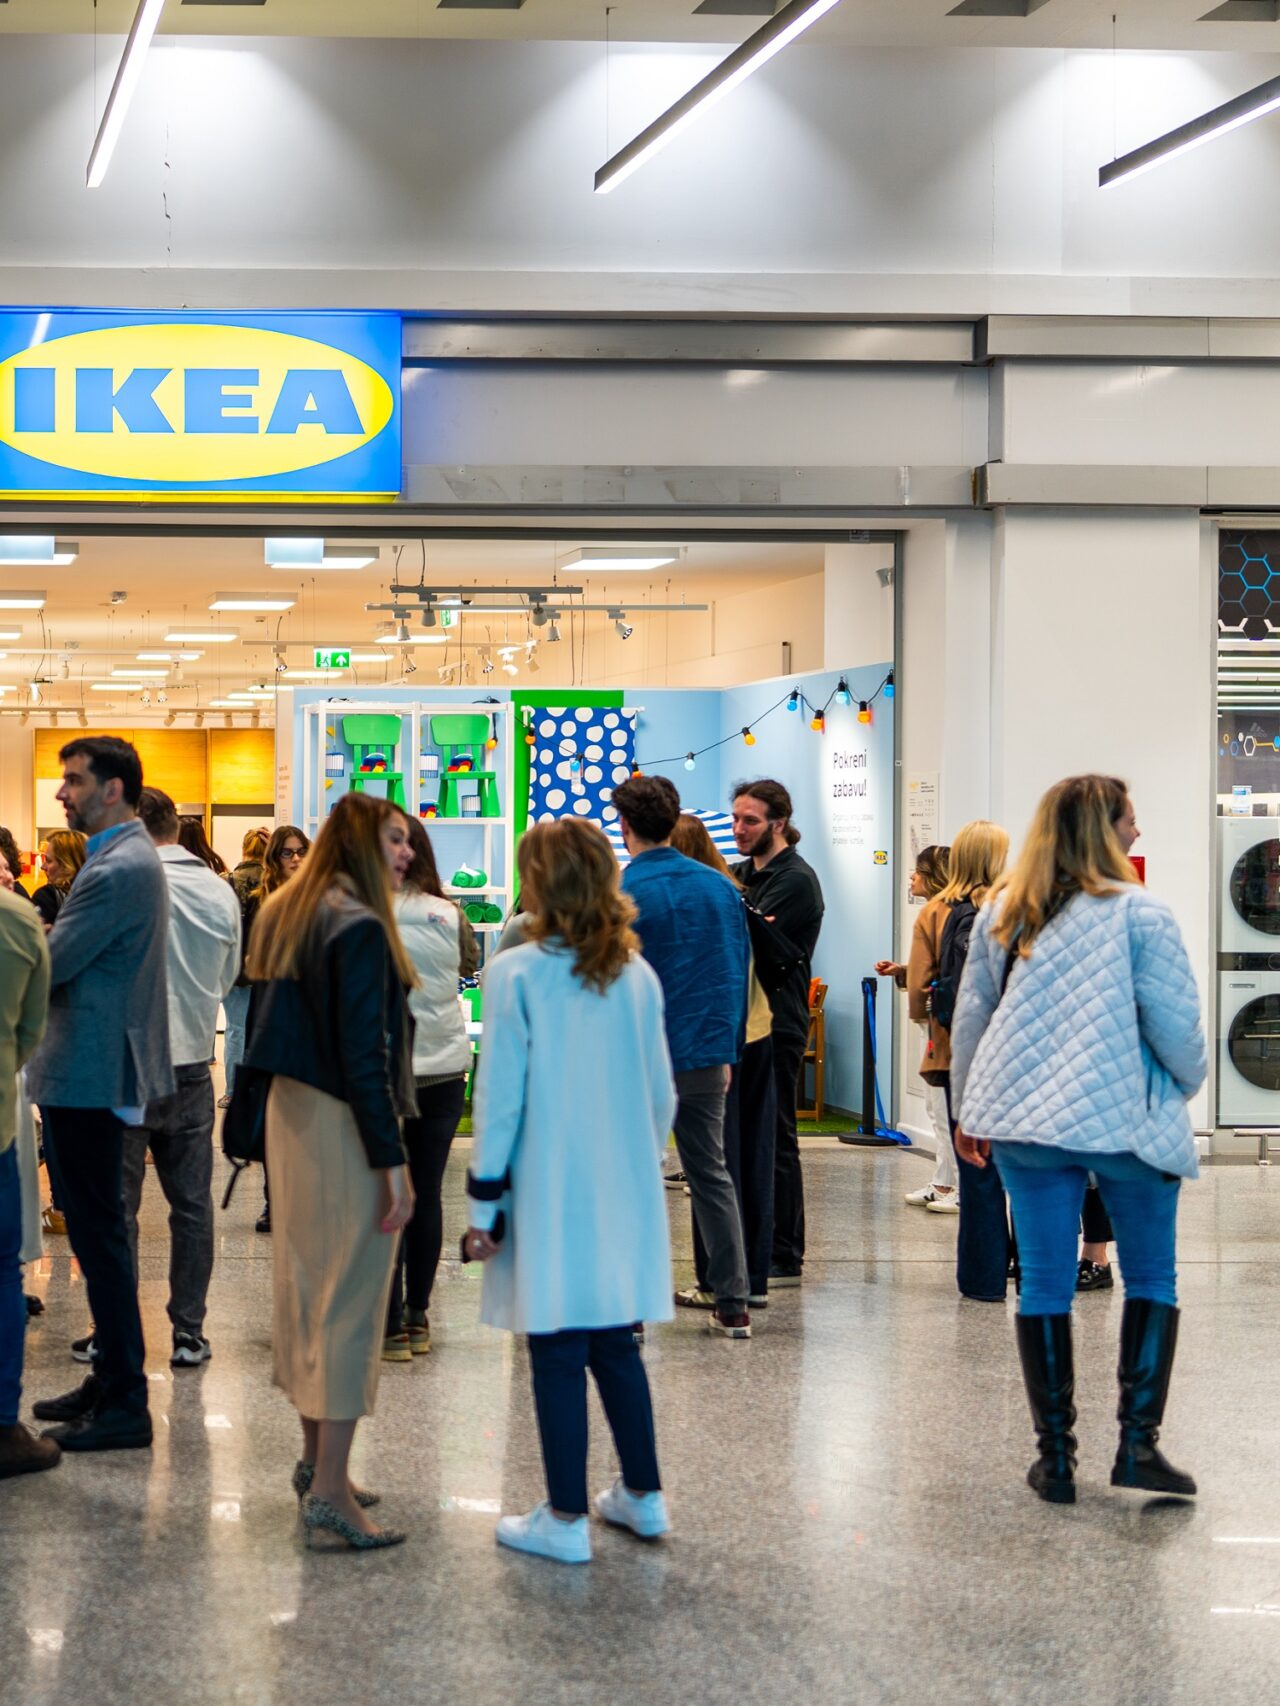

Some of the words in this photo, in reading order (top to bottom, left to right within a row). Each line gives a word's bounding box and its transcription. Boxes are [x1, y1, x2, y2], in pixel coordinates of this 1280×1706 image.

[14, 367, 366, 434] IKEA
[833, 749, 867, 769] Pokreni
[833, 779, 867, 798] zabavu!
